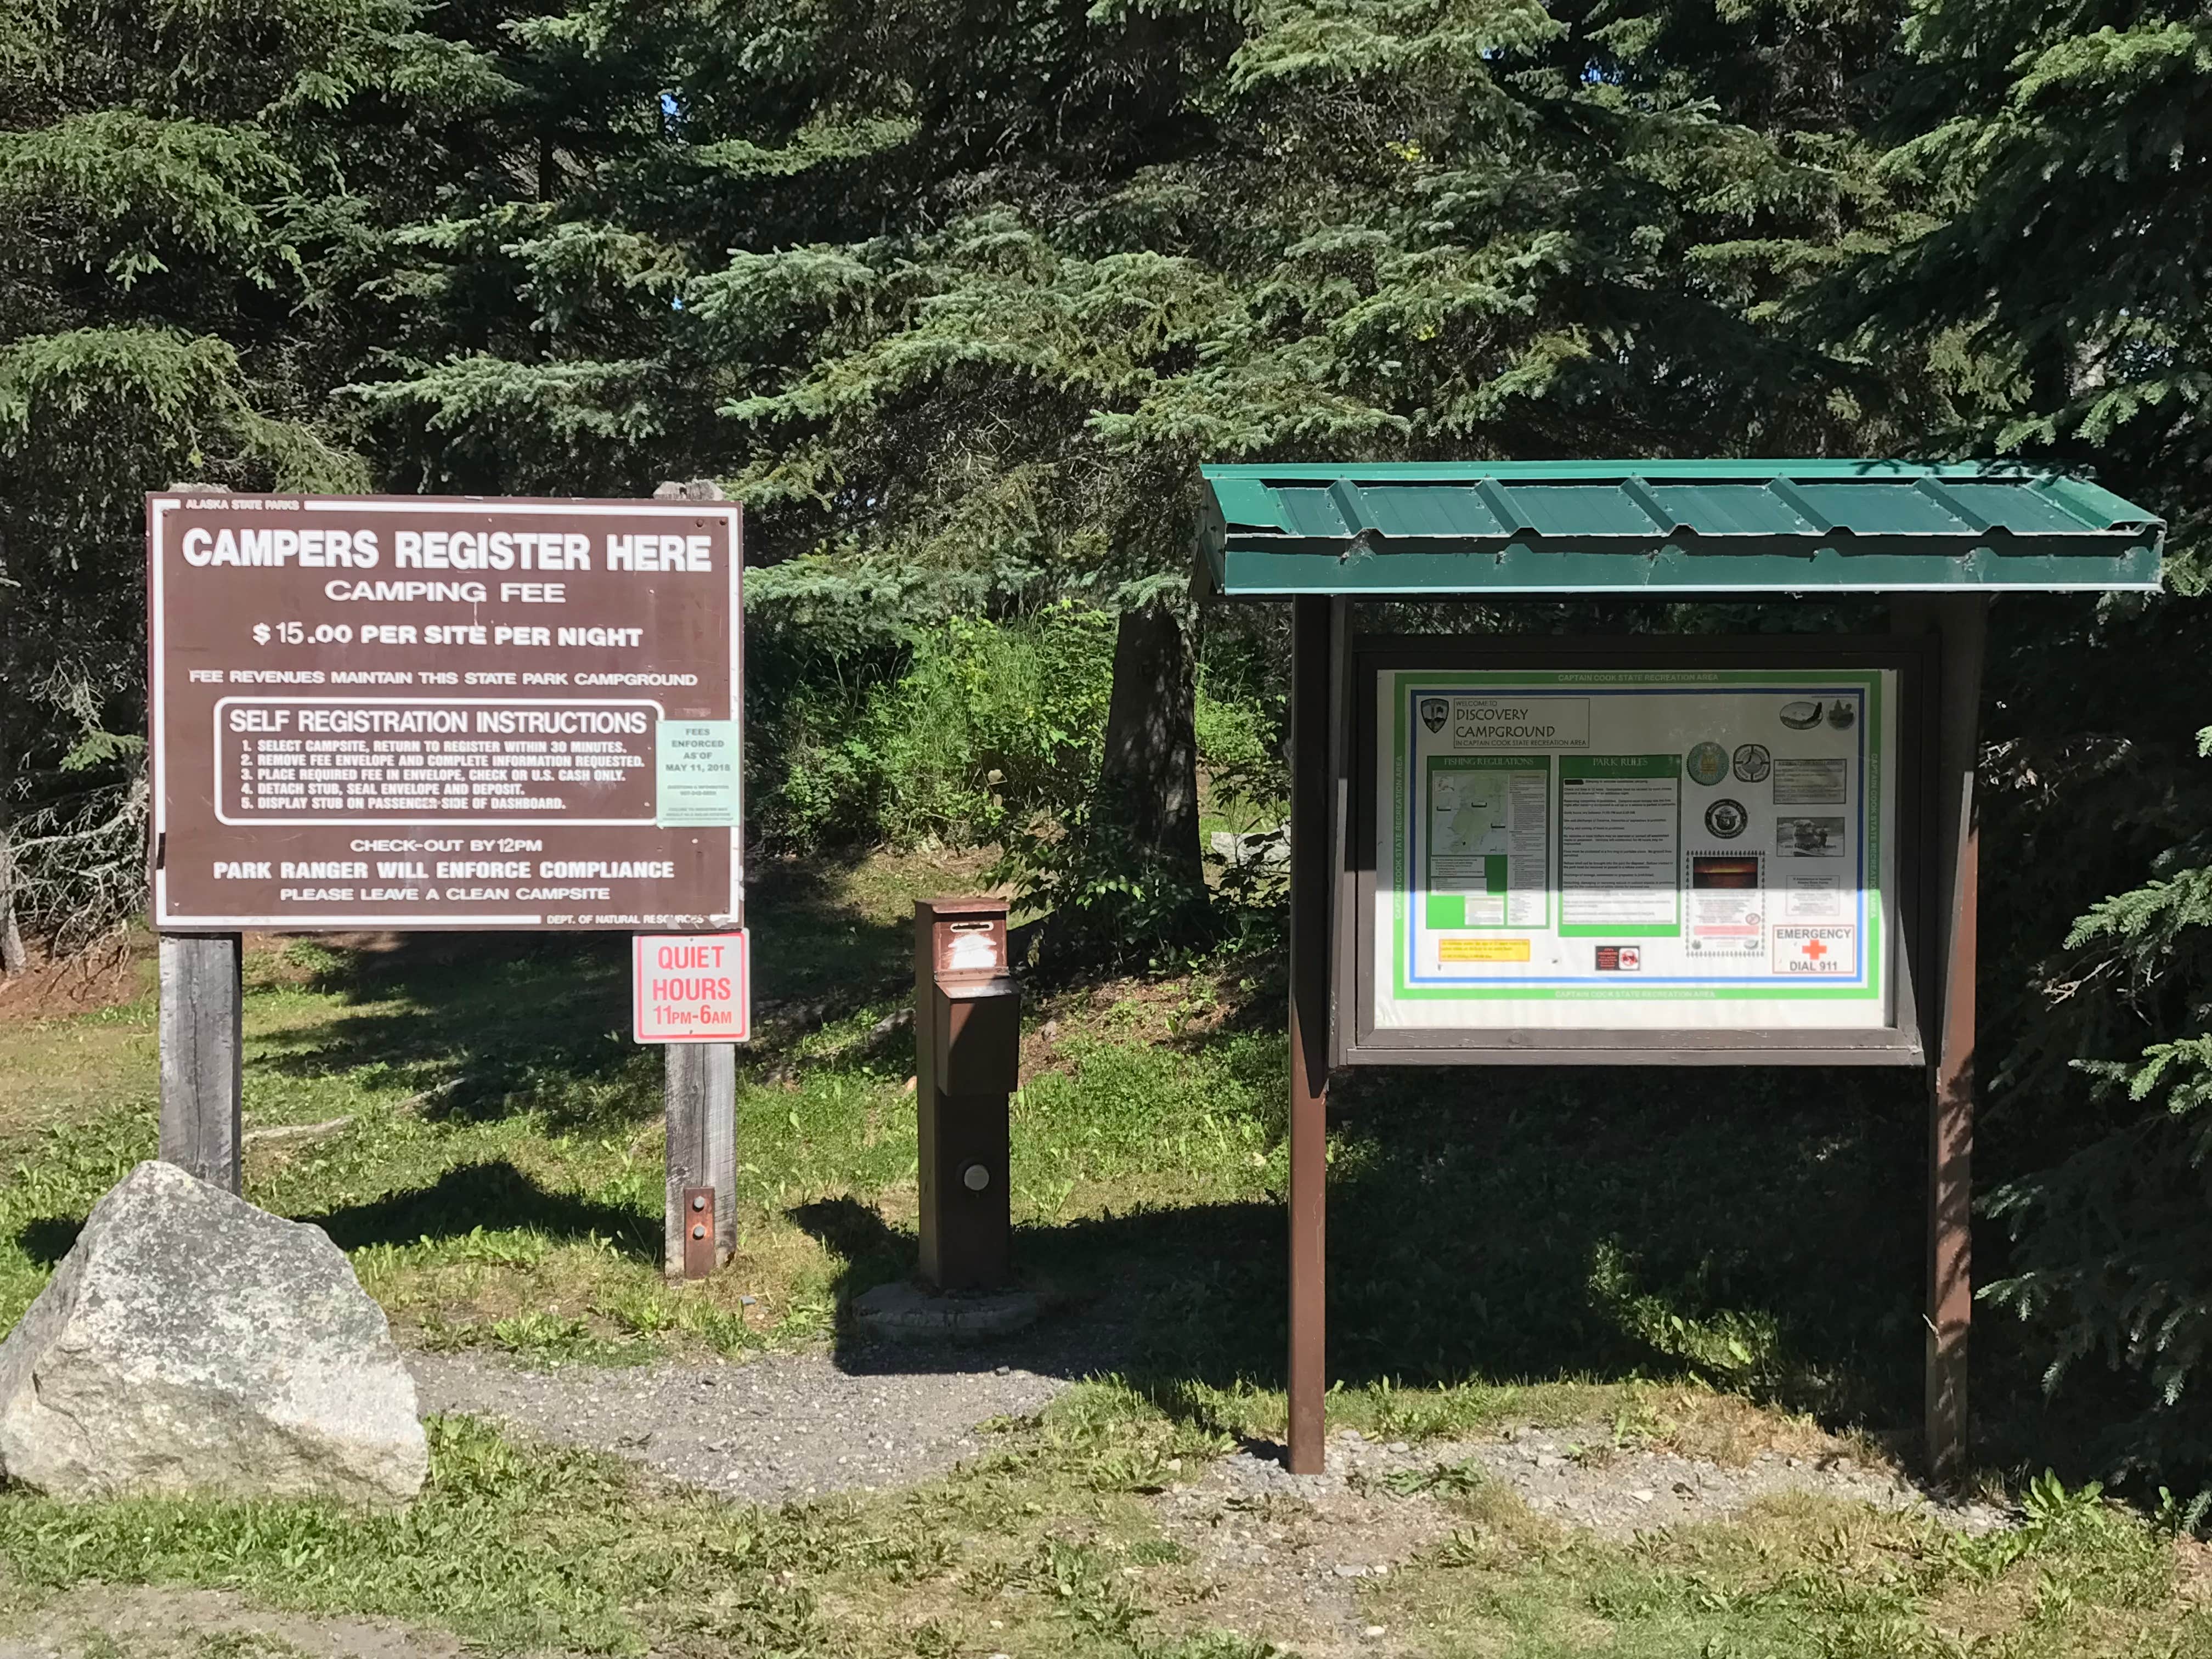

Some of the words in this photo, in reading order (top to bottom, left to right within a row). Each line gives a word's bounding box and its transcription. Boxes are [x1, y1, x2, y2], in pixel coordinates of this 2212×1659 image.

[186, 499, 228, 510] ALASKA
[232, 500, 262, 510] STATE
[265, 500, 300, 510] PARKS
[182, 528, 379, 568] CAMPERS
[395, 531, 590, 570] REGISTER
[606, 533, 712, 571] HERE
[325, 581, 486, 602] CAMPING
[500, 582, 566, 603] FEE
[361, 624, 417, 646] PER
[424, 625, 487, 646] SITE
[494, 626, 550, 647] PER
[558, 627, 643, 647] NIGHT
[189, 670, 223, 682] FEE
[229, 670, 325, 683] REVENUES
[331, 671, 412, 684] MAINTAIN
[418, 672, 458, 684] THIS
[465, 672, 516, 685] STATE
[522, 672, 568, 685] PARK
[574, 673, 698, 686] CAMPGROUND
[1456, 709, 1528, 720] DISCOVERY
[229, 709, 290, 732] SELF
[298, 710, 468, 733] REGISTRATION
[476, 710, 647, 733] INSTRUCTIONS
[1456, 726, 1555, 738] CAMPGROUND
[242, 740, 252, 752] 1.
[258, 740, 301, 752] SELECT
[306, 740, 370, 752] CAMPSITE,
[373, 741, 420, 753] RETURN
[425, 741, 439, 753] TO
[444, 741, 500, 753] REGISTER
[504, 741, 546, 753] WITHIN
[551, 741, 567, 753] 30
[571, 741, 627, 753] MINUTES.
[240, 754, 253, 766] 2.
[258, 754, 306, 766] REMOVE
[310, 754, 332, 766] FEE
[336, 755, 394, 767] ENVELOPE
[399, 755, 423, 767] AND
[427, 755, 489, 767] COMPLETE
[493, 755, 572, 767] INFORMATION
[575, 755, 645, 768] REQUESTED.
[1593, 758, 1618, 766] PARK
[1621, 758, 1648, 766] RULES
[240, 769, 253, 781] 3.
[258, 769, 295, 781] PLACE
[300, 769, 357, 781] REQUIRED
[362, 769, 382, 781] FEE
[387, 769, 399, 781] IN
[403, 769, 465, 781] ENVELOPE,
[469, 769, 507, 781] CHECK
[511, 769, 528, 781] OR
[532, 770, 555, 781] U.S.
[558, 770, 590, 781] CASH
[594, 770, 625, 781] ONLY.
[240, 783, 253, 795] 4.
[258, 783, 304, 795] DETACH
[308, 783, 343, 795] STUB,
[347, 783, 377, 795] SEAL
[381, 784, 439, 795] ENVELOPE
[444, 784, 468, 795] AND
[472, 784, 524, 795] DEPOSIT.
[240, 798, 253, 809] 5.
[258, 798, 308, 809] DISPLAY
[312, 798, 343, 809] STUB
[347, 798, 364, 809] ON
[472, 798, 487, 809] OF
[491, 798, 566, 809] DASHBOARD.
[350, 839, 464, 852] CHECK-OUT
[470, 839, 492, 852] BY
[497, 838, 542, 852] 12PM
[214, 862, 272, 878] PARK
[280, 862, 368, 878] RANGER
[376, 862, 428, 878] WILL
[437, 861, 531, 878] ENFORCE
[539, 861, 674, 878] COMPLIANCE
[280, 889, 354, 900] PLEASE
[360, 888, 419, 900] LEAVE
[425, 888, 439, 900] A
[445, 888, 509, 900] CLEAN
[515, 888, 610, 900] CAMPSITE
[547, 915, 576, 924] DEPT.
[578, 915, 593, 924] OF
[595, 915, 640, 924] NATURAL
[1777, 929, 1851, 939] EMERGENCY
[658, 946, 724, 970] QUIET
[1790, 961, 1816, 971] DIAL
[1819, 961, 1838, 971] 911
[653, 977, 731, 1001] HOURS
